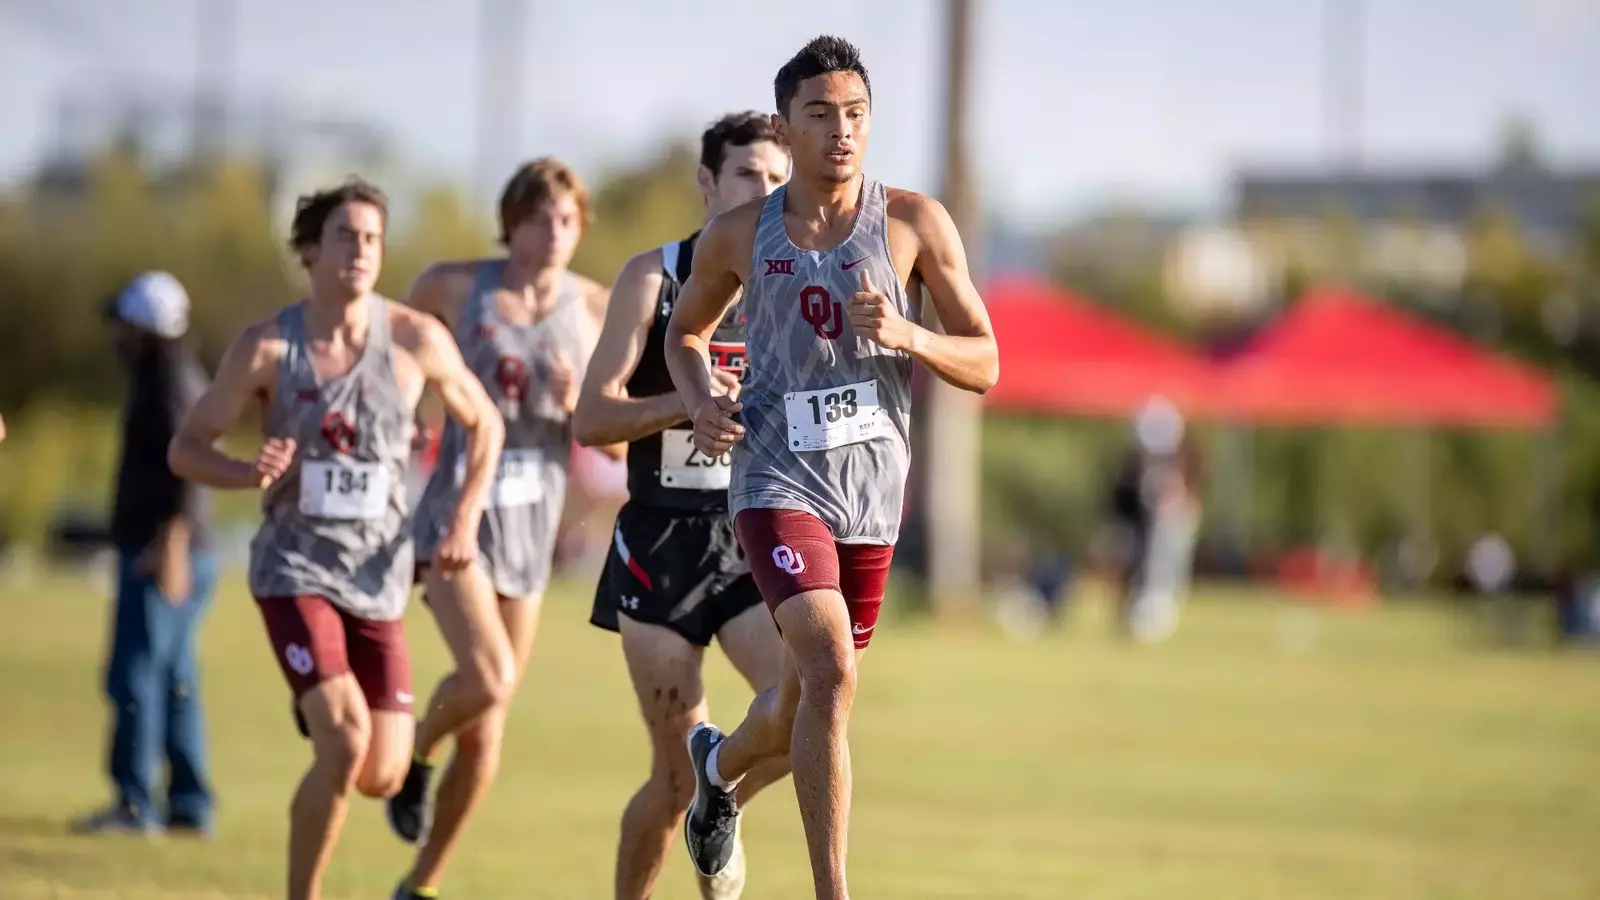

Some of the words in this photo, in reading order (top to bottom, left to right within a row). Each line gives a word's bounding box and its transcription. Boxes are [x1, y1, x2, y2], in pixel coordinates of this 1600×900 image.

[800, 286, 843, 340] OU
[807, 389, 858, 425] 133
[324, 469, 369, 493] 134
[772, 543, 806, 575] OU
